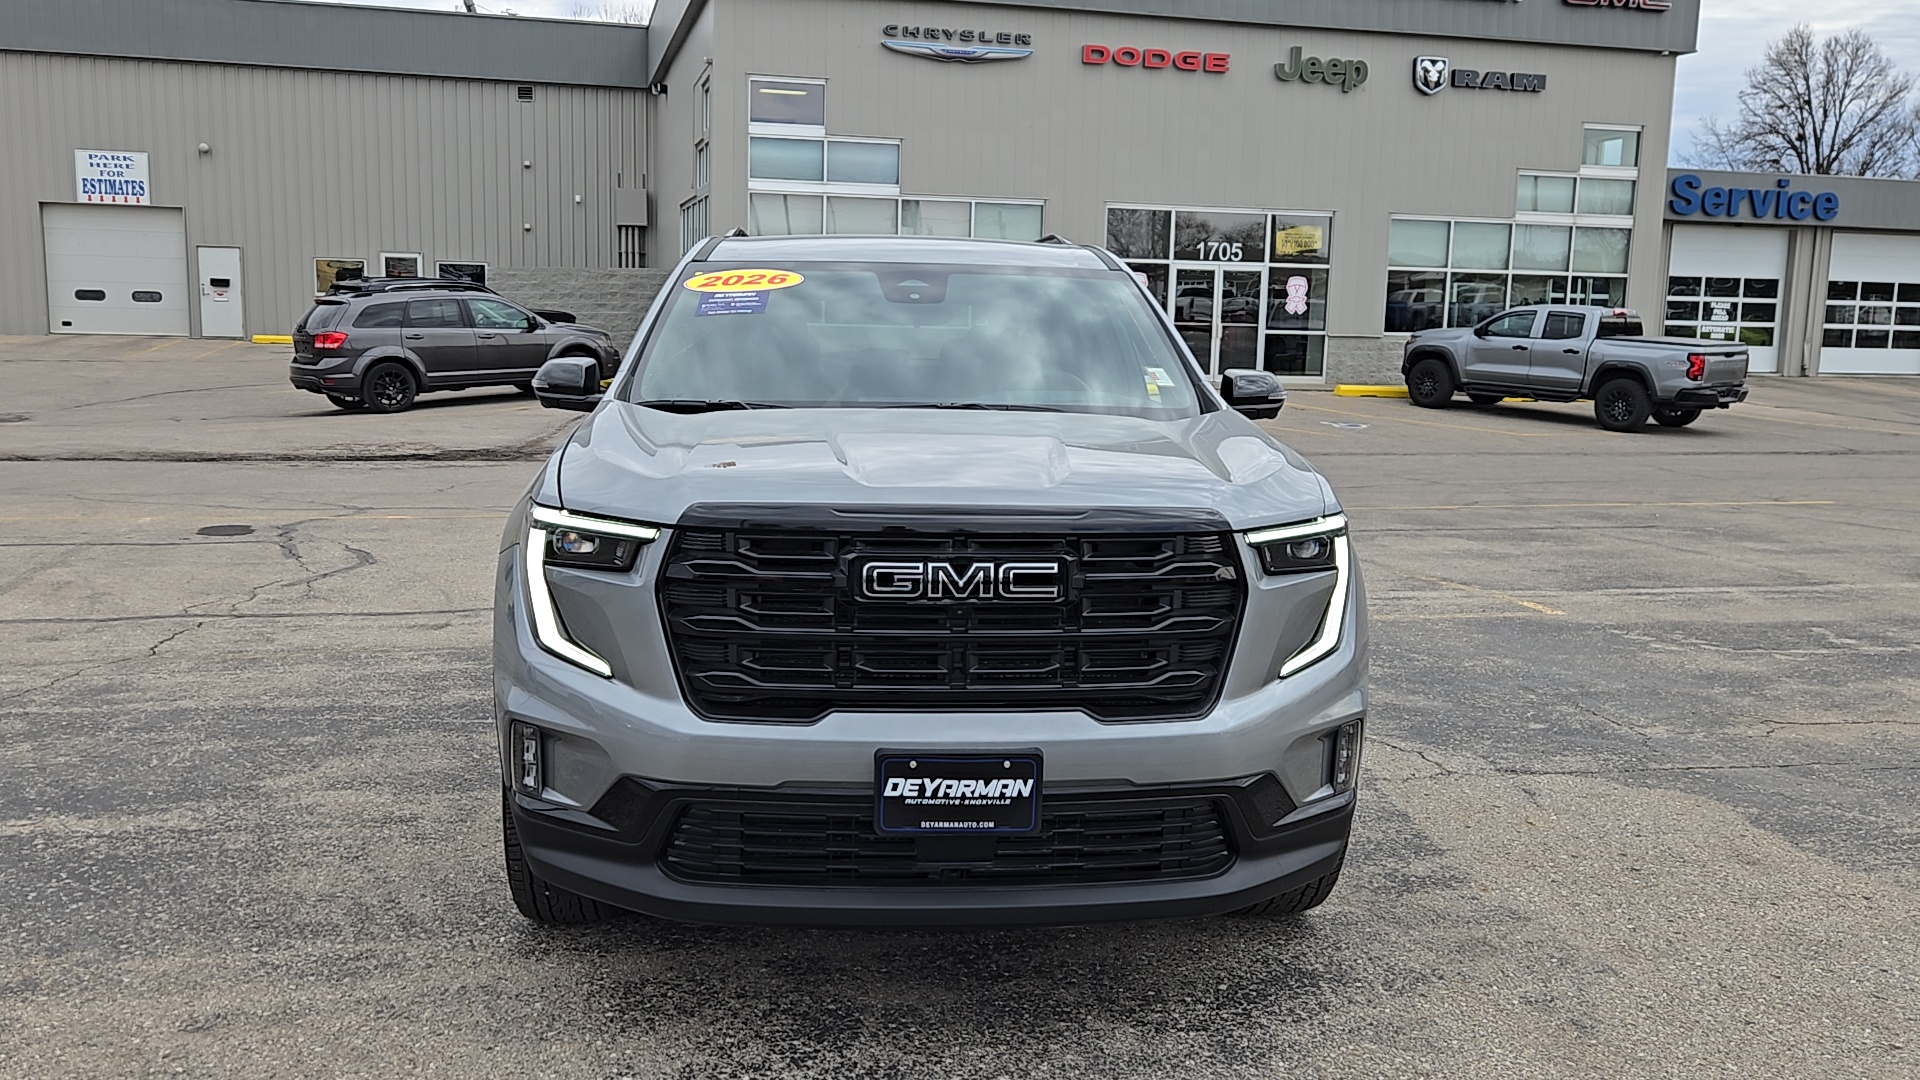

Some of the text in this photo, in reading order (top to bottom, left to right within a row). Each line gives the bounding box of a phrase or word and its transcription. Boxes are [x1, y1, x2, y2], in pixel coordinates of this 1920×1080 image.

[883, 24, 1032, 45] CHRYSLER
[1082, 44, 1231, 73] DODGE
[1274, 46, 1369, 93] Jeep
[1451, 68, 1547, 93] RAM
[88, 153, 135, 162] PARK
[99, 169, 125, 177] FOR
[81, 177, 146, 197] ESTIMATES
[1669, 174, 1840, 221] Service
[1196, 241, 1243, 261] 1705
[696, 274, 790, 288] 2026
[863, 562, 1058, 597] GMC
[883, 777, 1034, 798] DEYARMAN
[920, 821, 995, 829] DEYARMANAUTO.COM
